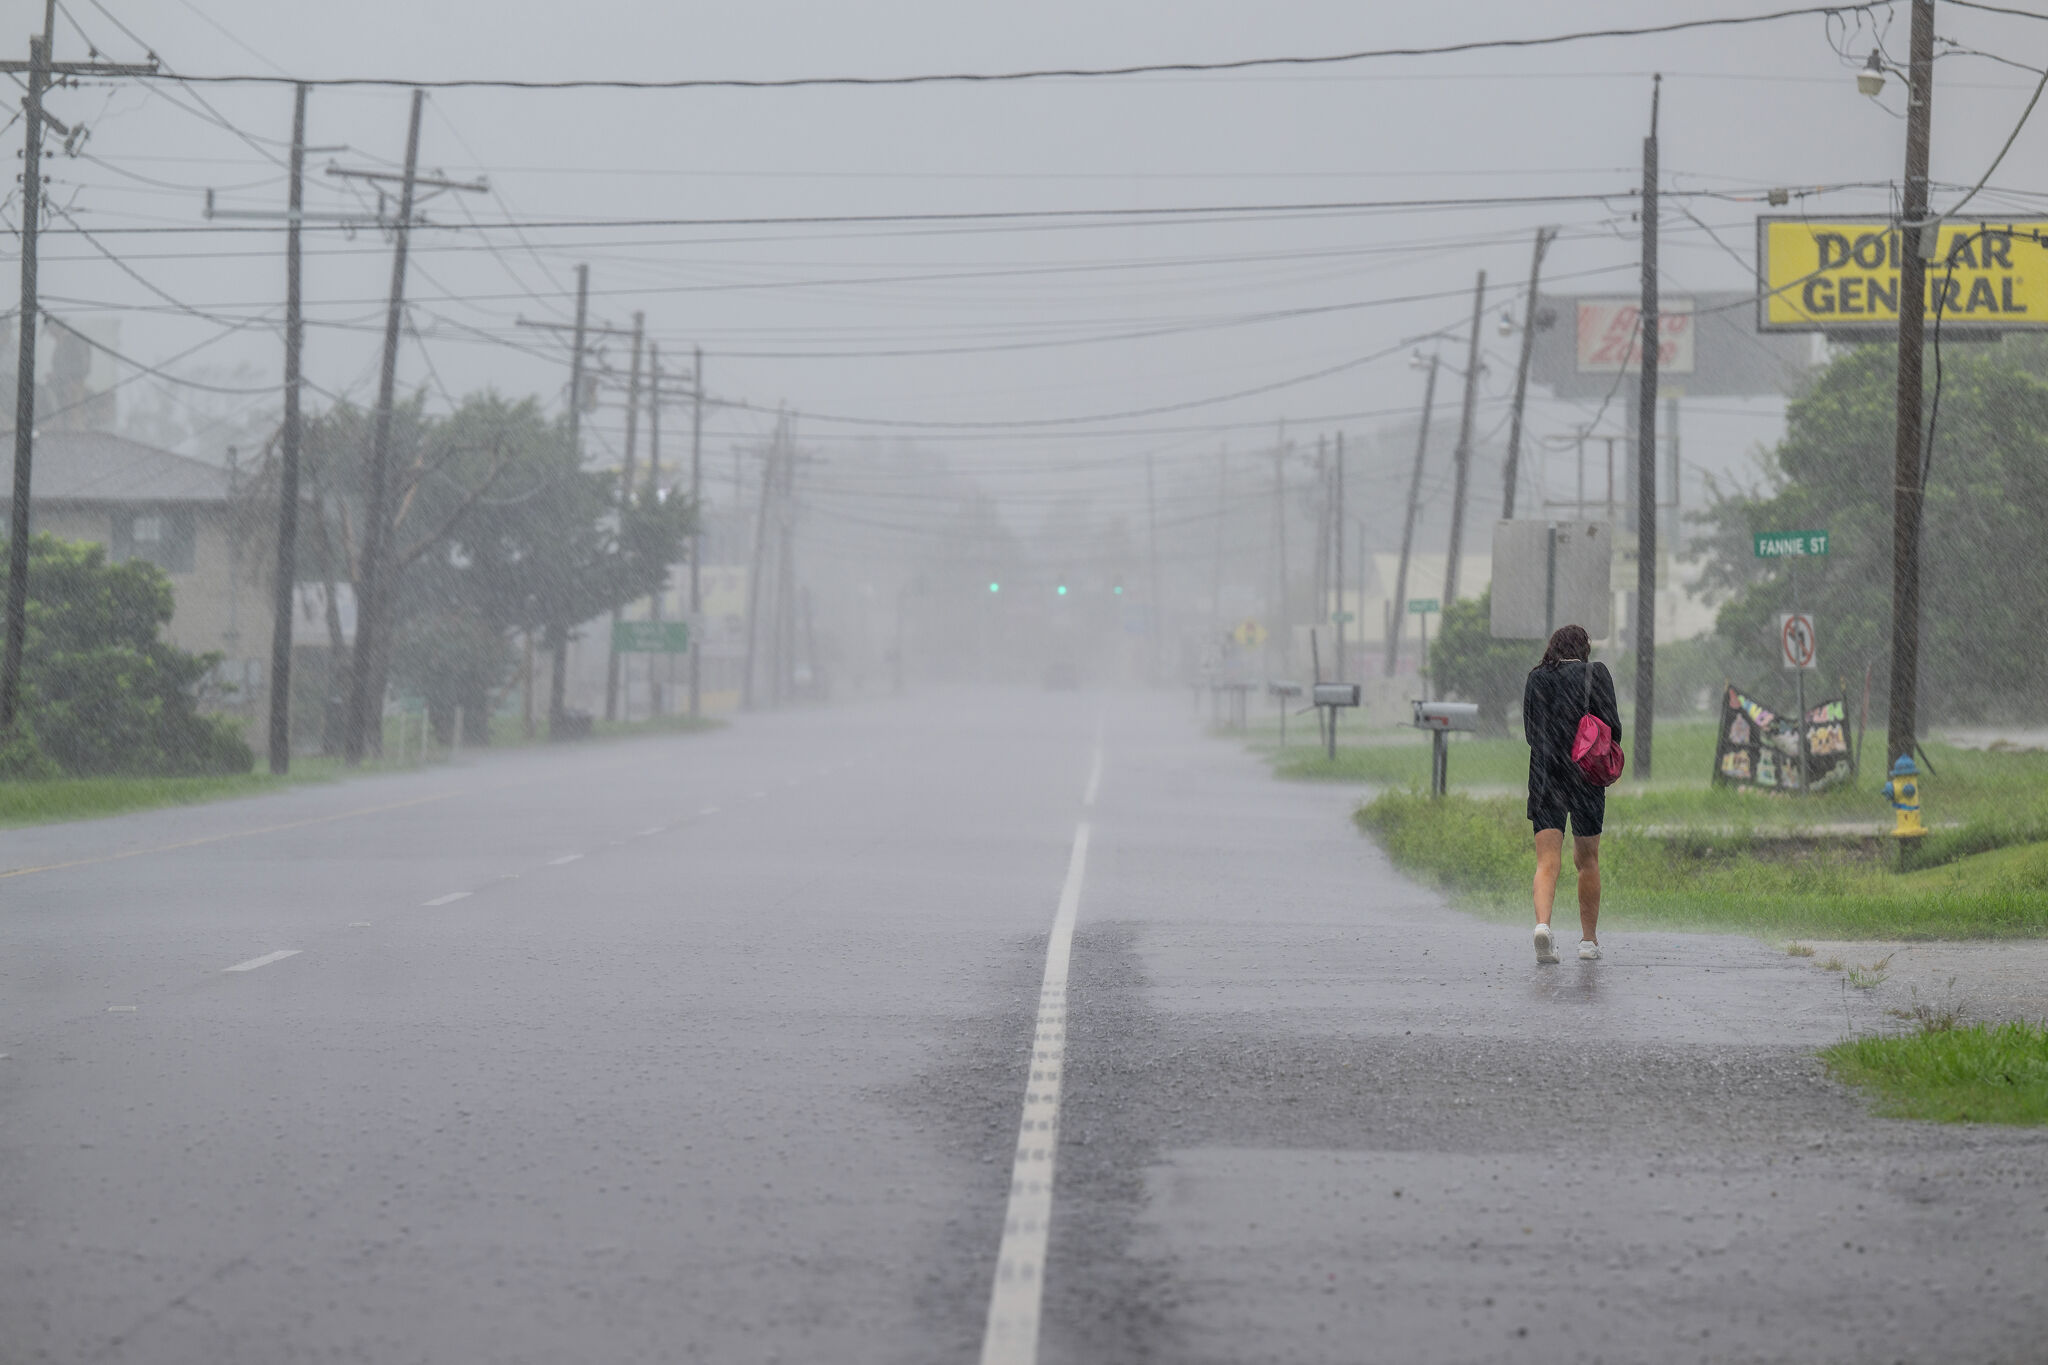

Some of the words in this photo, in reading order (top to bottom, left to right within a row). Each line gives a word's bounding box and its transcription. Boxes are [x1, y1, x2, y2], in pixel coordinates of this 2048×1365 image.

[1815, 232, 2014, 270] DOLAR
[1802, 276, 2027, 314] GENRAL
[1760, 538, 1805, 556] FANNIE
[1810, 536, 1827, 553] ST
